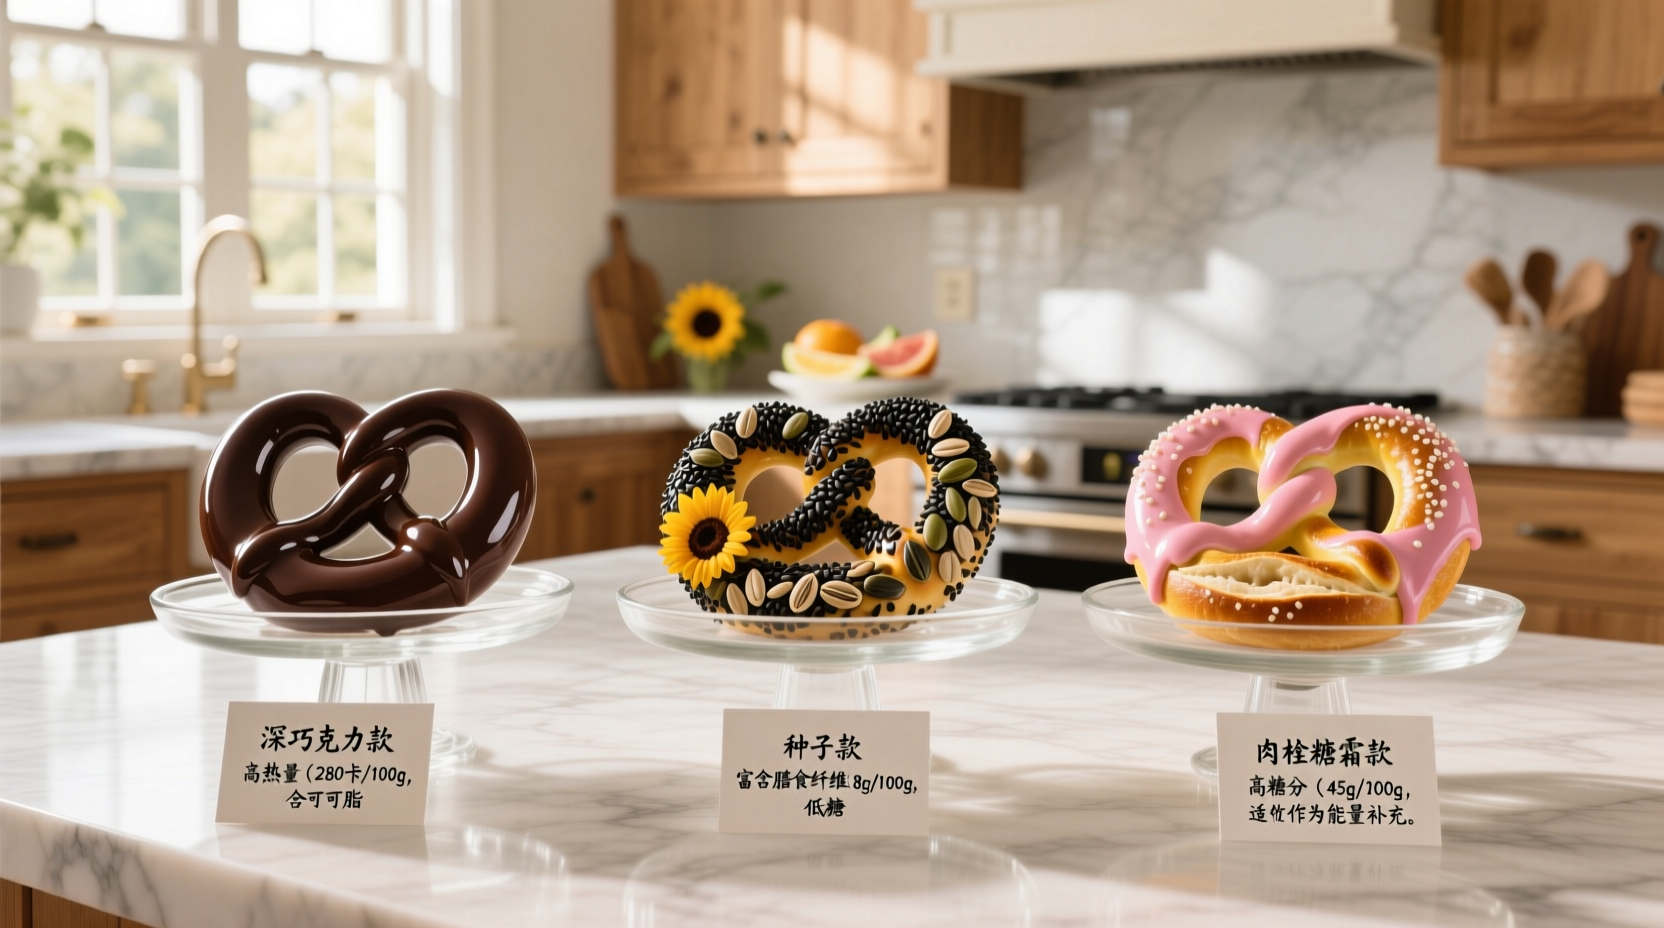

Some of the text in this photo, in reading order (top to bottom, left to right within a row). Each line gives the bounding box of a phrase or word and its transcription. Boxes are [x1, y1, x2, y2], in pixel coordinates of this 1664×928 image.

[260, 723, 395, 754] 深巧克力款
[783, 732, 863, 761] 种子款
[1257, 736, 1394, 768] 肉栓糖霜款
[803, 796, 847, 818] 低糖
